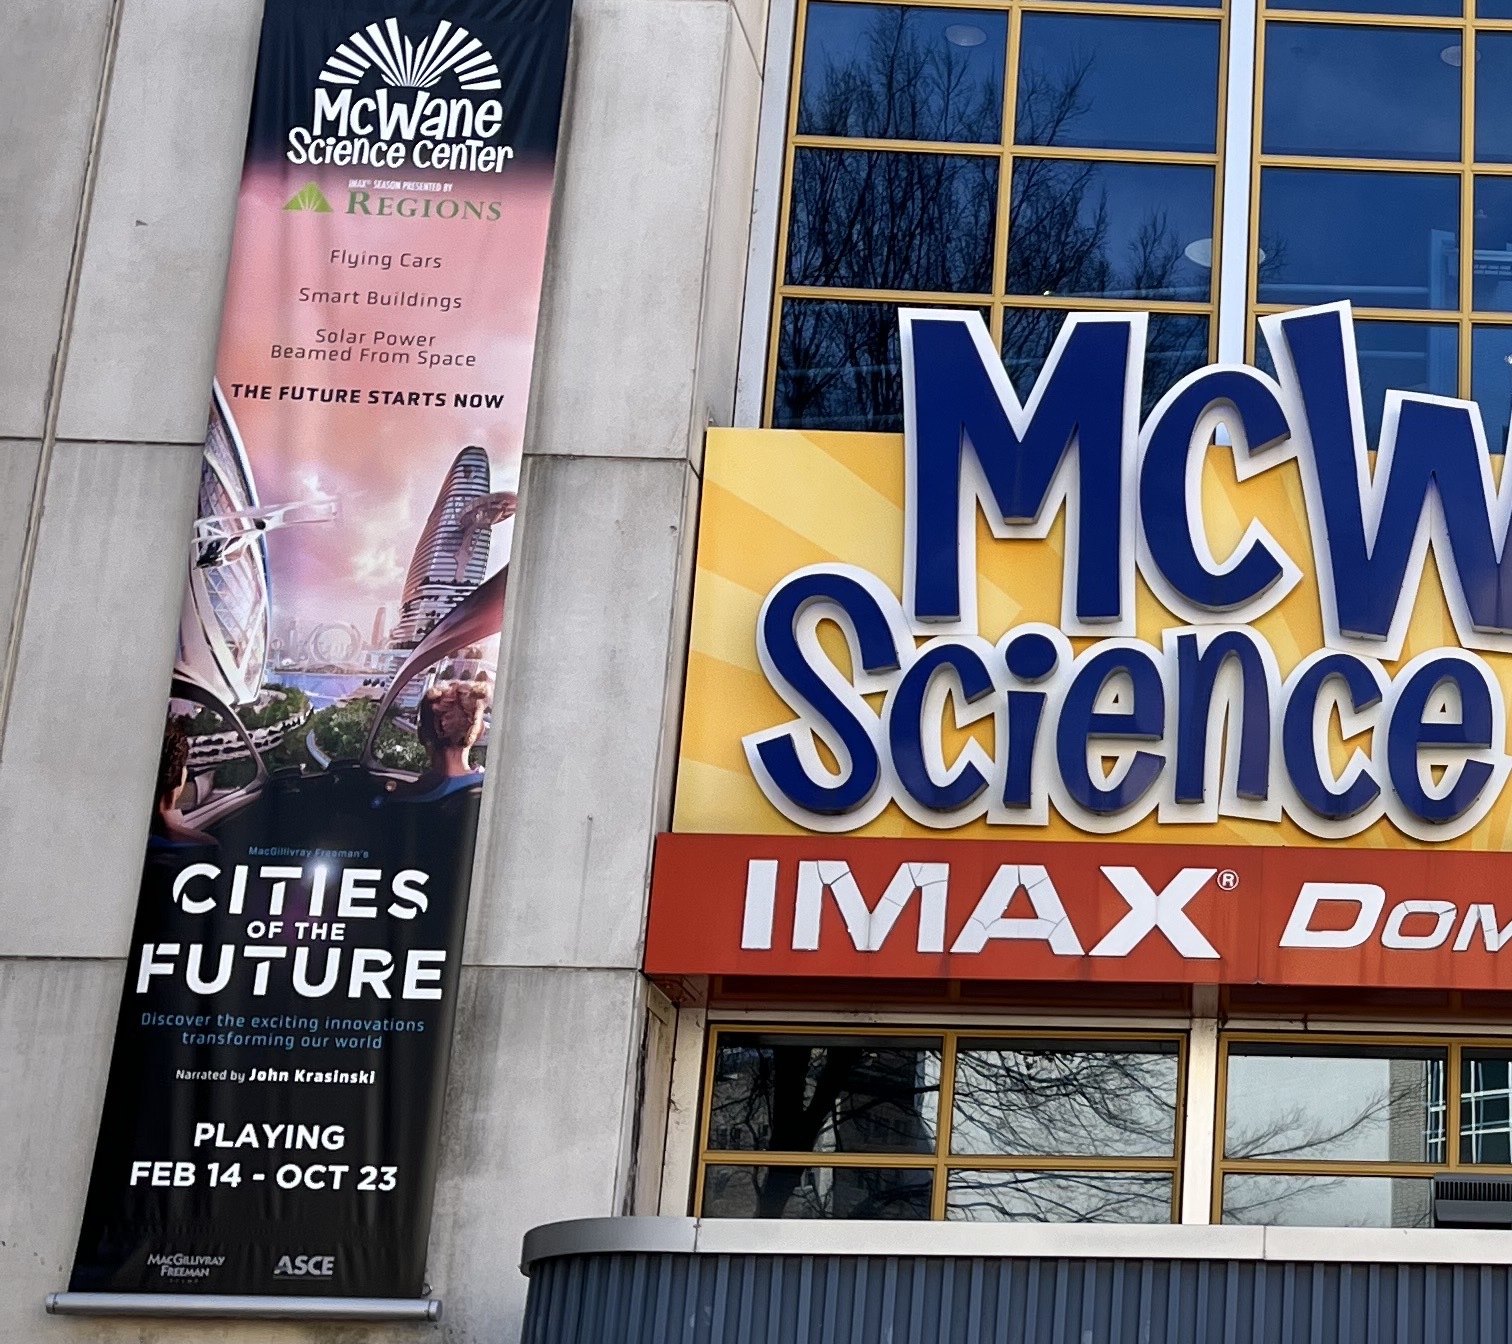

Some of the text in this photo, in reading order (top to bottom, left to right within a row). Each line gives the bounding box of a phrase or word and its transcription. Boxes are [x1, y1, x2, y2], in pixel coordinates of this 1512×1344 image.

[312, 87, 503, 140] McWane
[286, 126, 406, 169] Science
[402, 181, 442, 192] PRESENTED
[442, 182, 453, 193] BY
[330, 249, 442, 270] Flying Cars
[299, 287, 463, 312] Smart Buildings
[315, 328, 436, 347] Solar Power
[271, 344, 477, 369] Beamed From Space
[231, 383, 505, 409] THE FUTURE STARTS NOW
[248, 846, 312, 858] MacGillivray
[172, 863, 430, 920] CITIES
[246, 921, 346, 941] OF THE
[135, 943, 447, 1001] FUTURE
[141, 1012, 425, 1032] Discover the exciting innovations
[182, 1031, 383, 1050] transforming our world
[176, 1068, 375, 1084] Narrated by John Krasinski
[194, 1122, 345, 1150] PLAYING
[129, 1161, 196, 1187] FEB
[207, 1162, 242, 1188] 14
[276, 1164, 349, 1190] OCT
[357, 1165, 398, 1191] 23
[273, 1255, 335, 1276] ASCE
